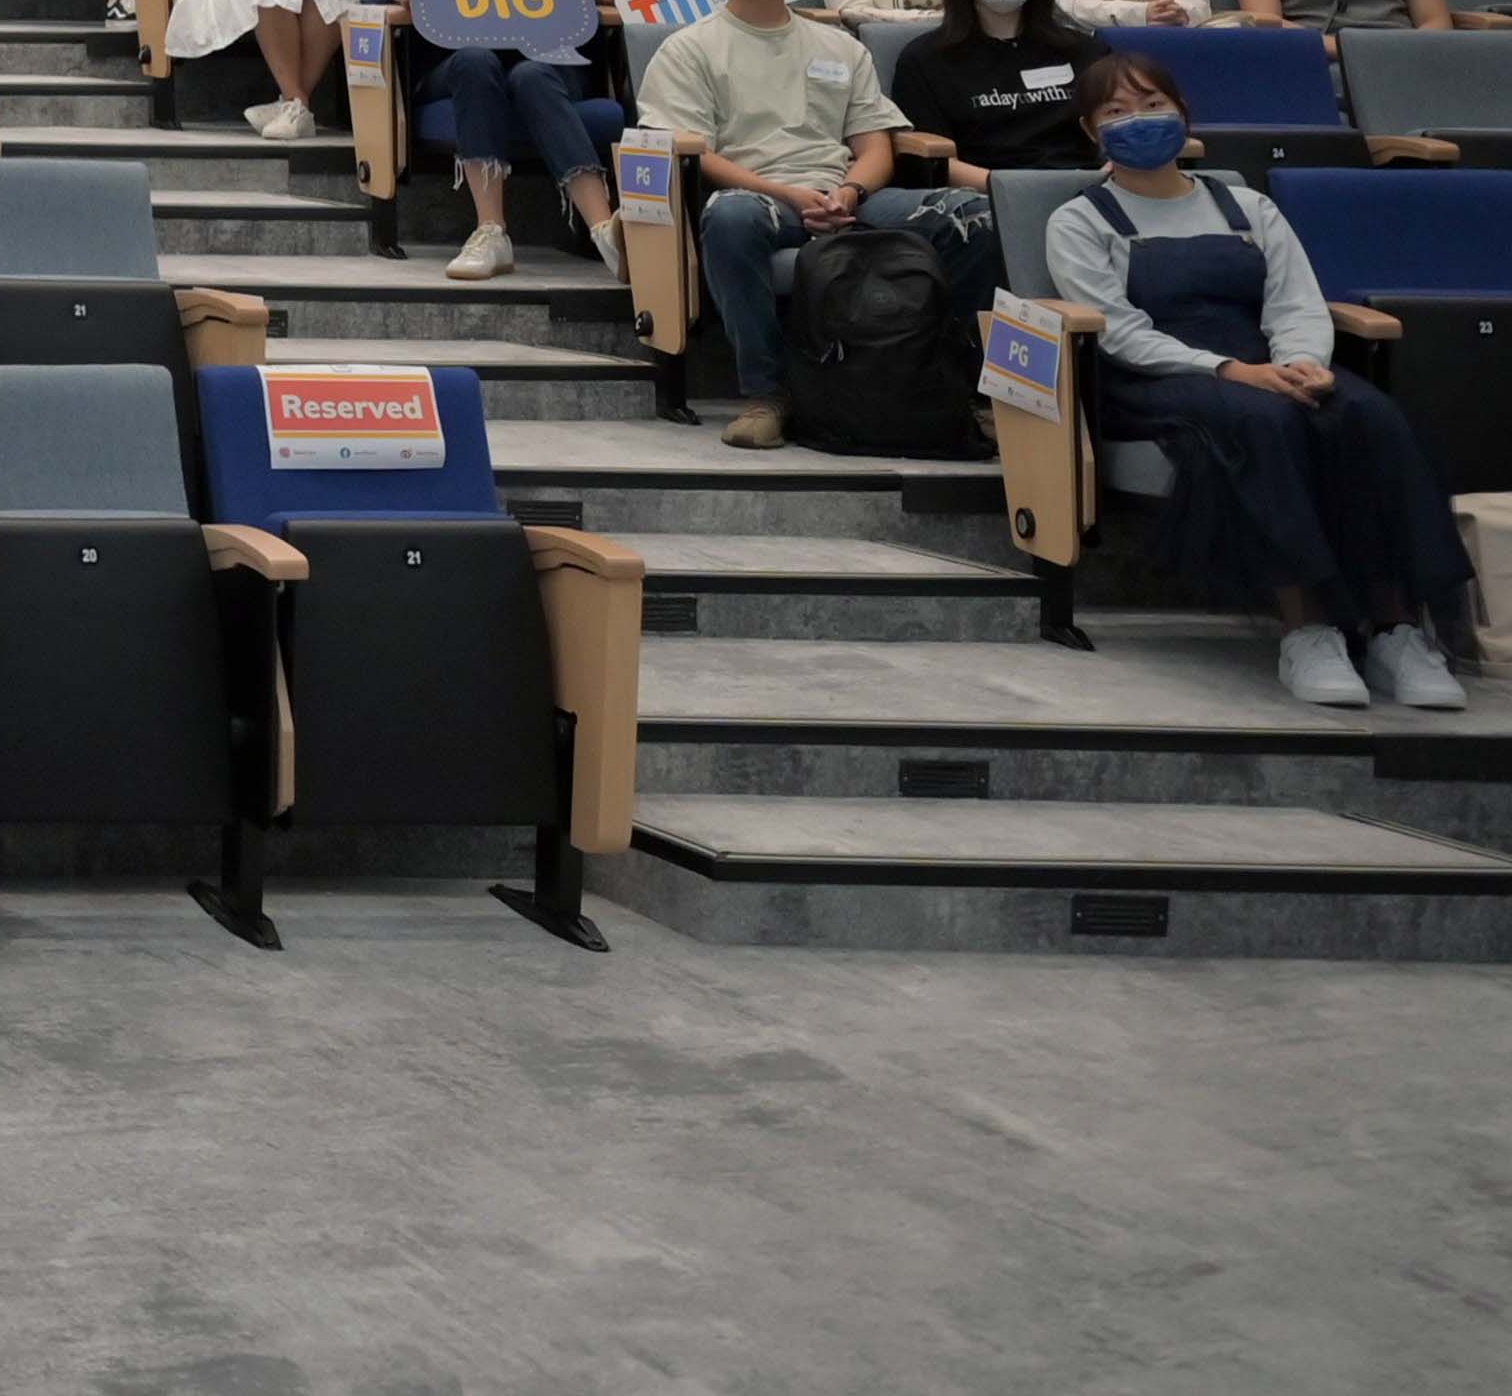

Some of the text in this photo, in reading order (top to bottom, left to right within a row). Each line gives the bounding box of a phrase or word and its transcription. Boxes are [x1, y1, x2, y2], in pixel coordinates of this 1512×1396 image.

[636, 166, 651, 187] PG
[74, 304, 86, 317] 21
[1479, 321, 1493, 334] 23
[1008, 340, 1029, 369] PG
[281, 394, 425, 420] Reserved
[82, 548, 97, 563] 20
[407, 550, 421, 565] 21
